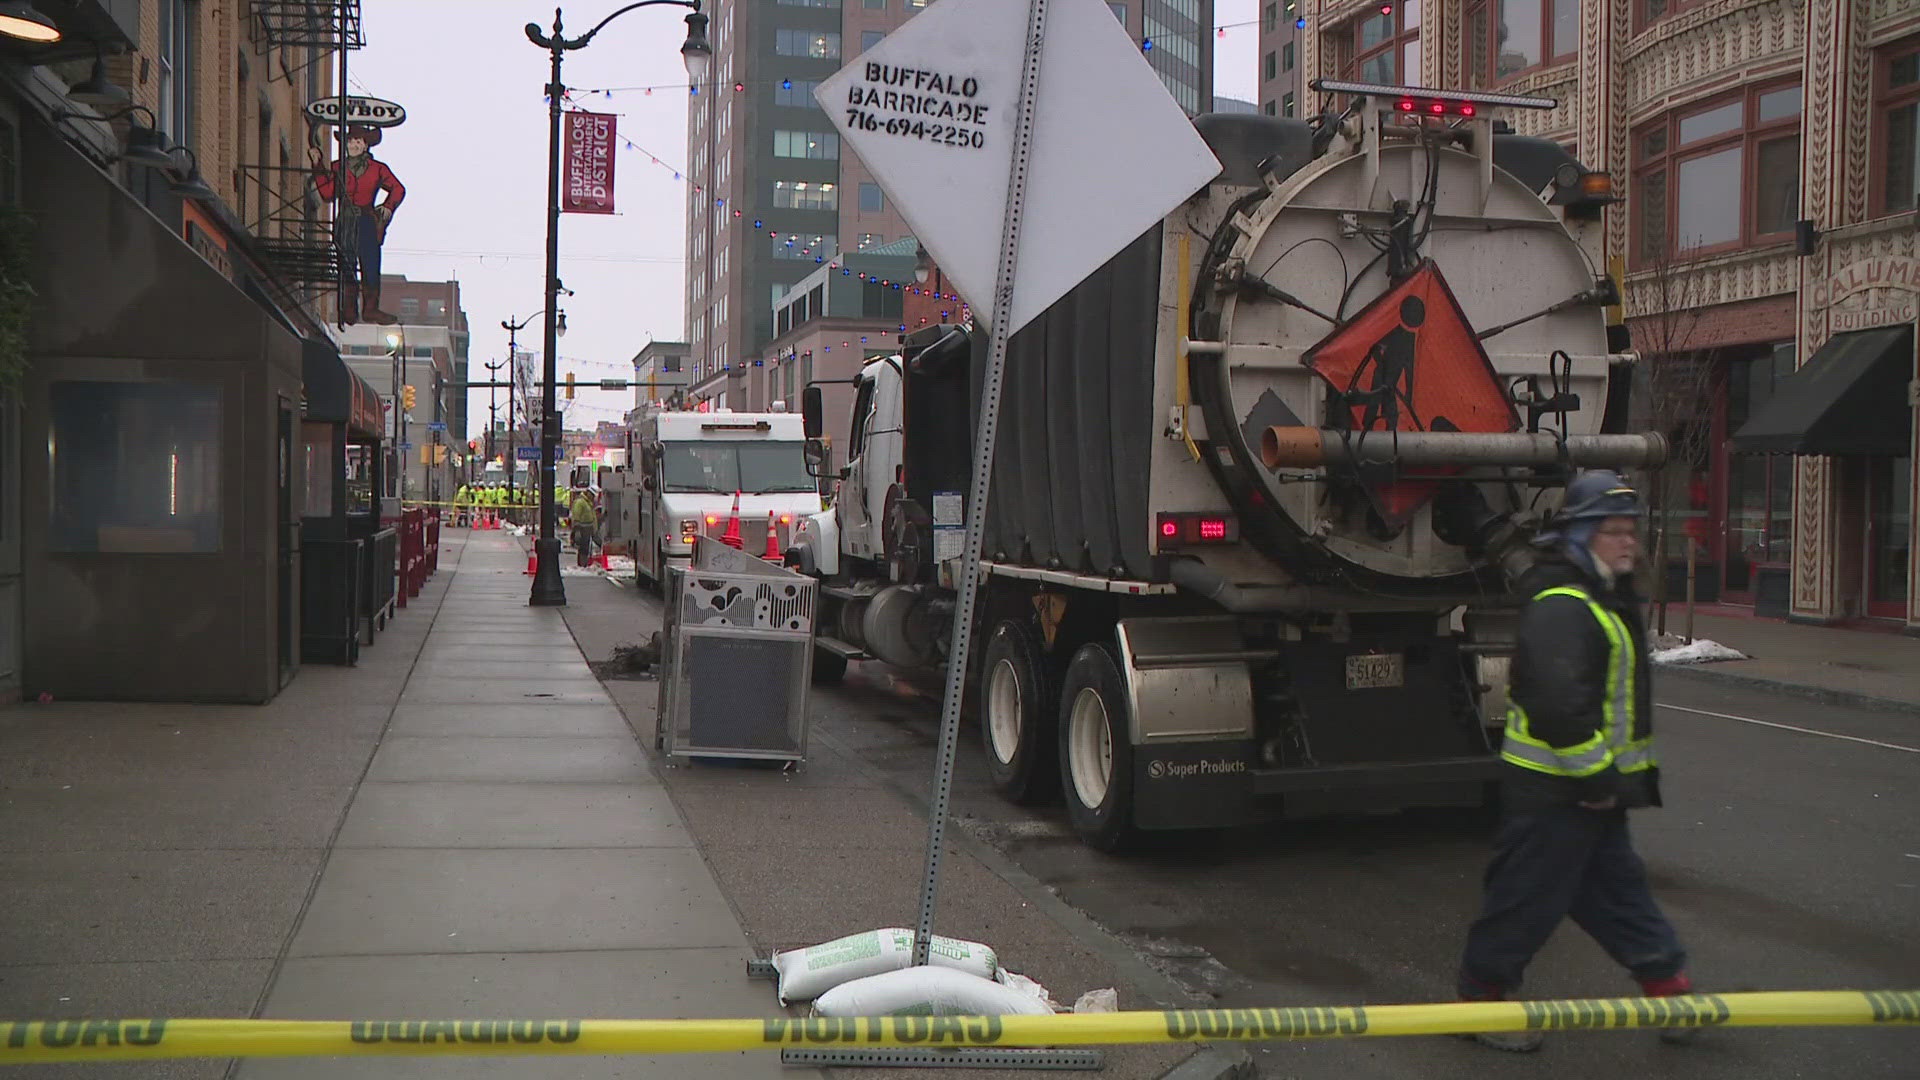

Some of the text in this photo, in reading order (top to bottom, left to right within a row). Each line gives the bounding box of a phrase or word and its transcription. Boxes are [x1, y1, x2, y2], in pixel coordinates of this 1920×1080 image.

[866, 62, 978, 98] BUFFALO
[848, 86, 988, 125] BARRICADE
[846, 109, 984, 149] 716-694-2250
[584, 116, 594, 198] ENTERTAINMENT
[592, 117, 609, 198] DISTRICT
[1834, 305, 1912, 329] BUILDING
[532, 399, 543, 408] ON
[520, 448, 542, 459] Asbur
[1167, 759, 1246, 779] Super Products
